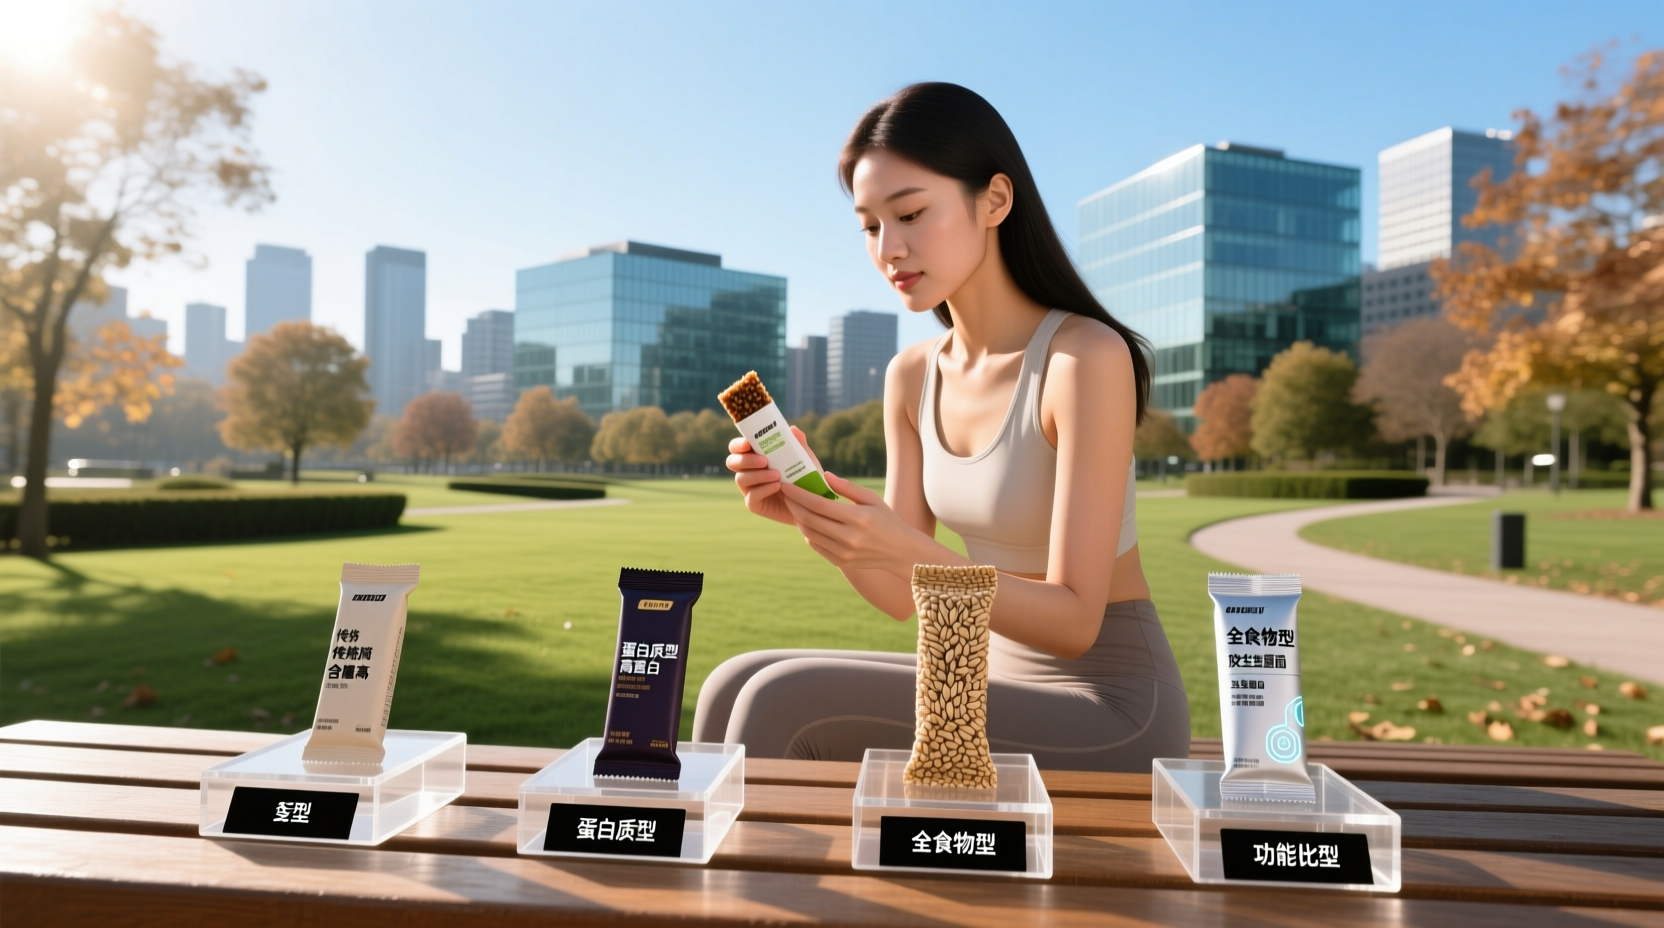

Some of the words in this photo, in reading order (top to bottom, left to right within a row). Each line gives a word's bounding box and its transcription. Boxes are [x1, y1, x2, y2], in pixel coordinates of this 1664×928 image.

[1226, 626, 1295, 647] 全食物型
[576, 817, 657, 842] 蛋白质型
[911, 829, 996, 856] 全食物型
[1253, 842, 1341, 868] 功能比型
